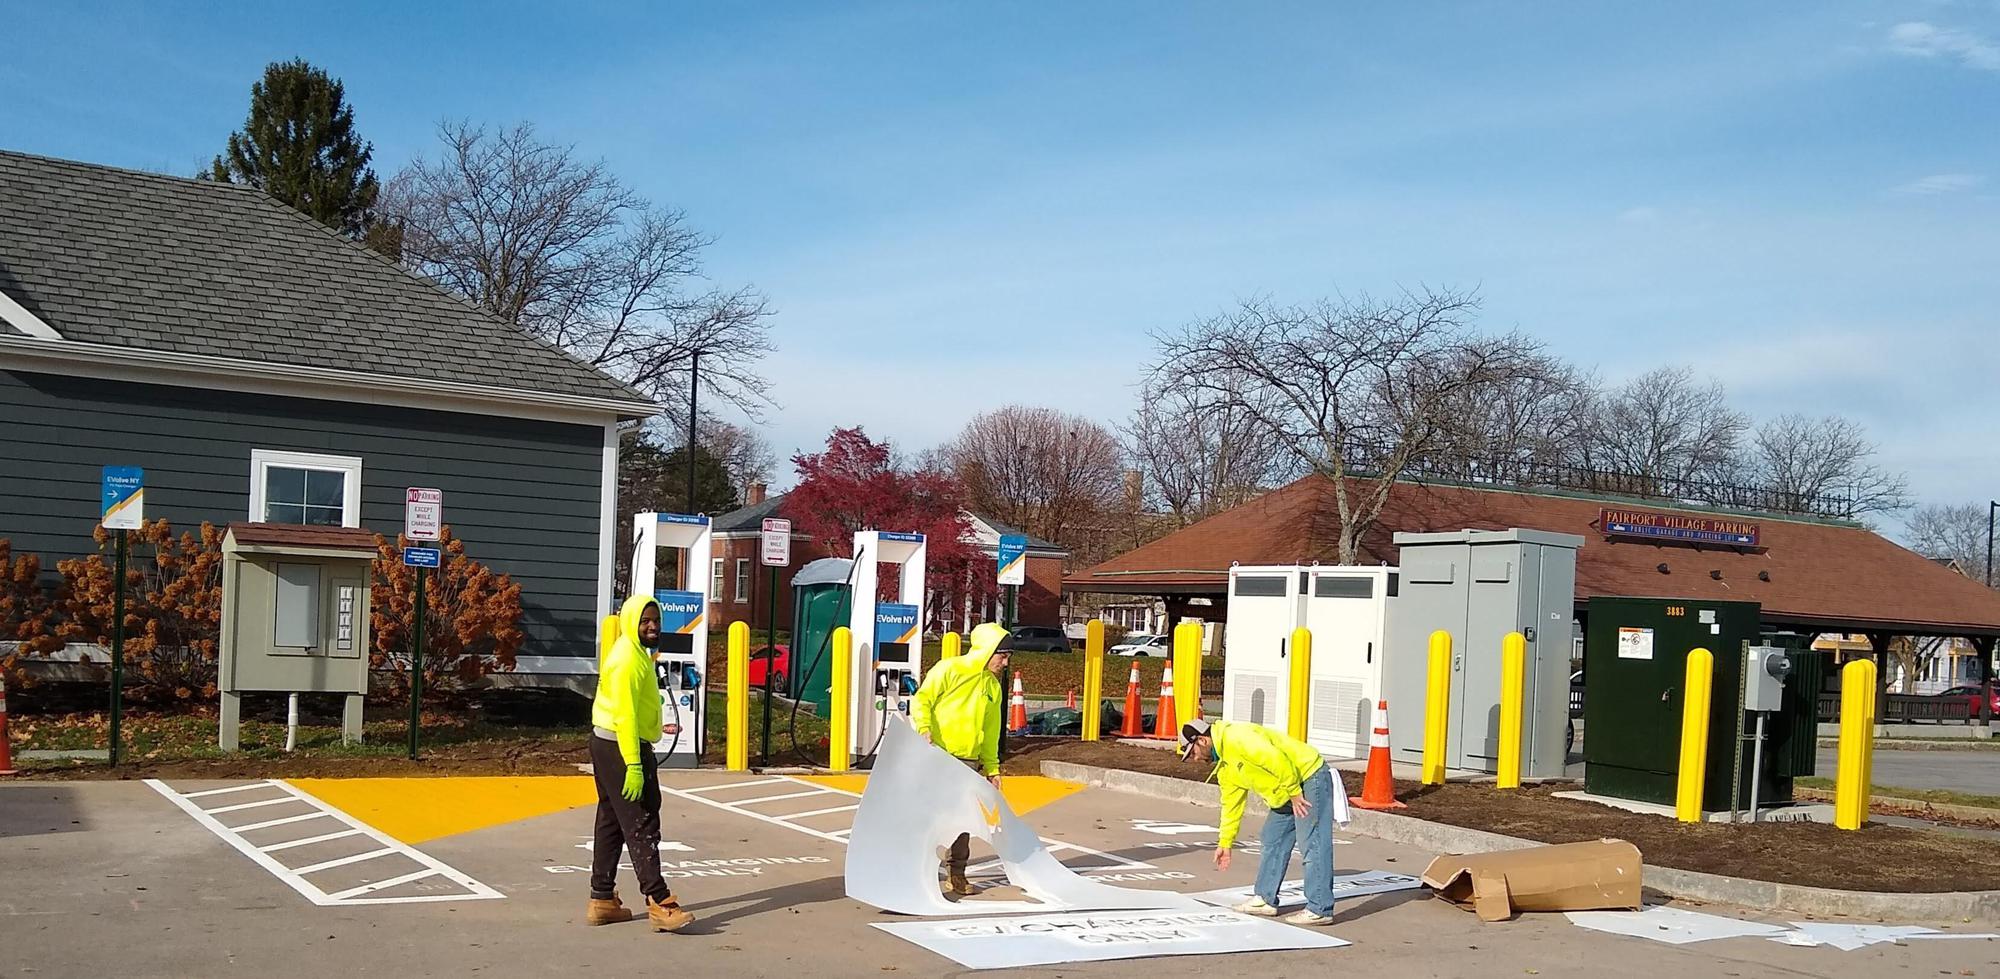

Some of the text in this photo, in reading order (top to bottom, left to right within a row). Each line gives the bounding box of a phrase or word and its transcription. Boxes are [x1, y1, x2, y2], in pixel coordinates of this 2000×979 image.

[408, 490, 440, 501] NO PARKING
[1606, 511, 1755, 535] FAIRPORT VILLAGE PARKING
[1630, 525, 1651, 533] PUBLIC
[1697, 532, 1721, 540] PARKING
[661, 602, 700, 613] Volve NY
[1666, 606, 1685, 616] 3883
[876, 614, 915, 624] EVolve NY
[661, 867, 765, 878] ONLY
